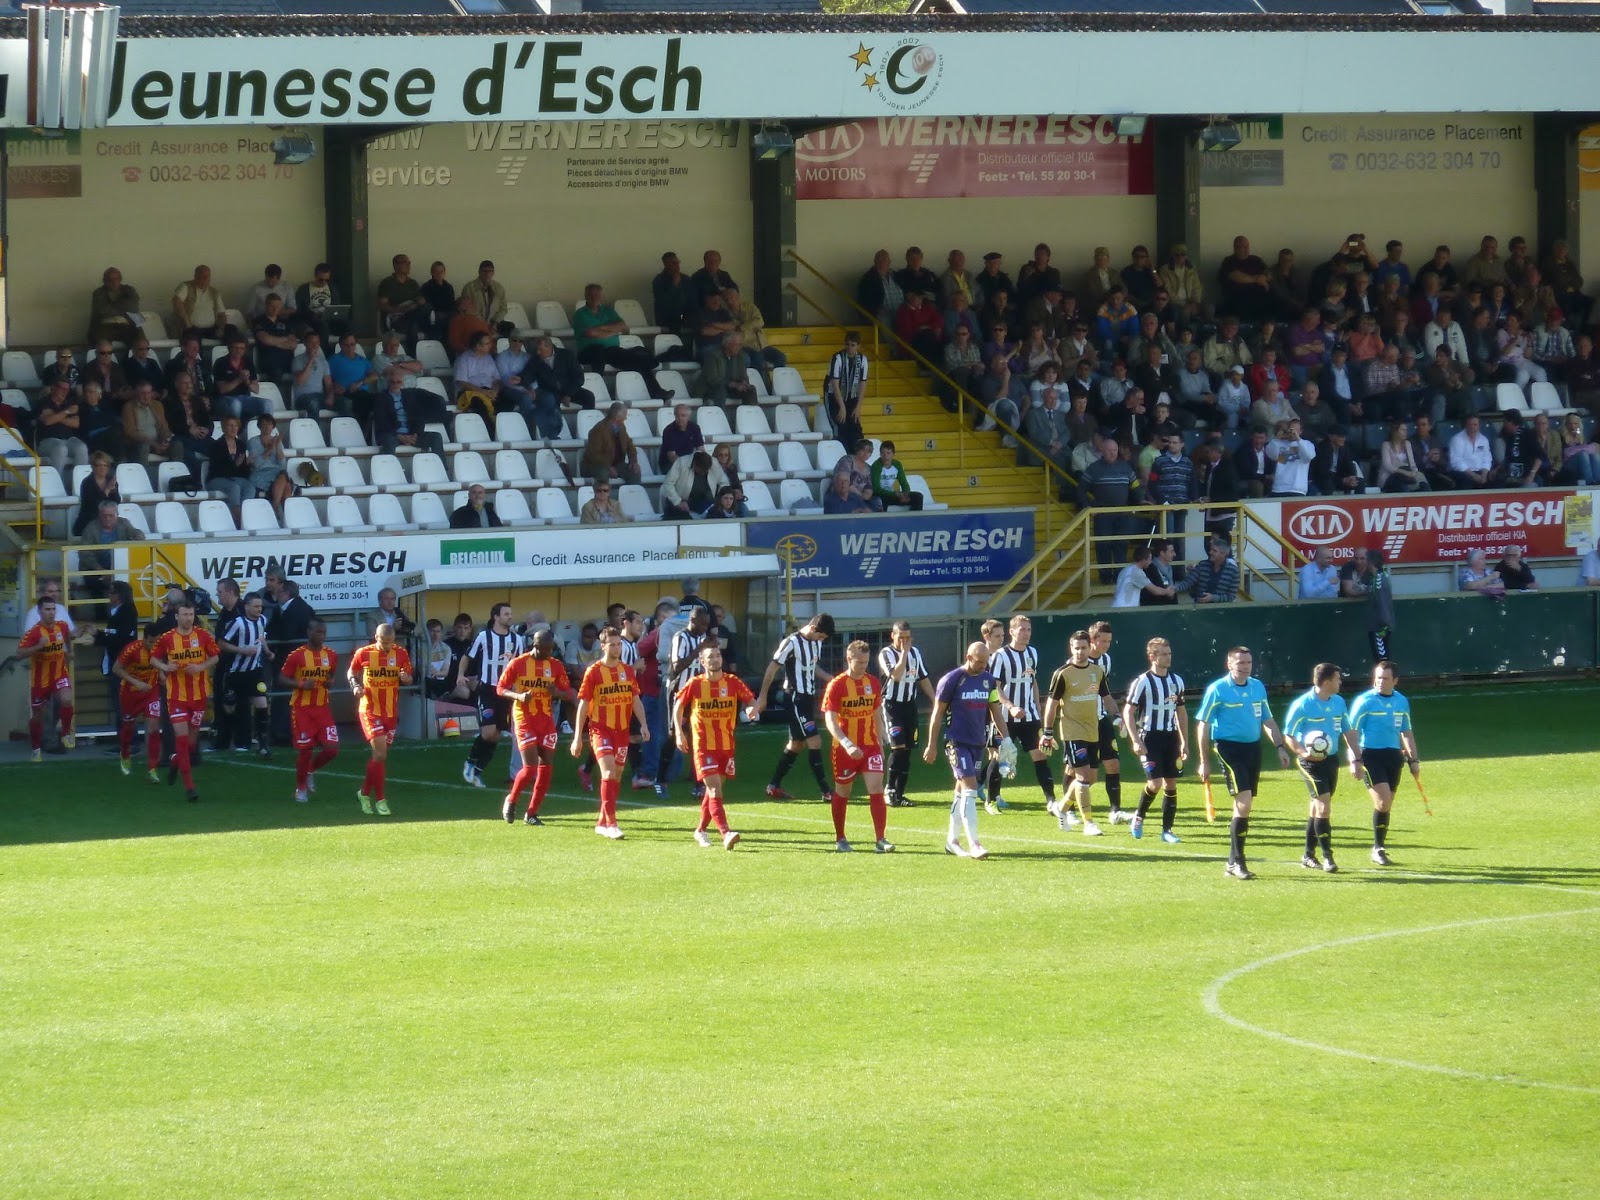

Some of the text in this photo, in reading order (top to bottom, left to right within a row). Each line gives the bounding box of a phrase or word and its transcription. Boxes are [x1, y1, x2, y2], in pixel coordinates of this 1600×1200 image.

[897, 38, 920, 46] 2007
[107, 37, 703, 120] Jeunesse d'Esch
[908, 81, 939, 110] JEUNESSE
[367, 119, 740, 151] MW WERNER ESCH
[878, 116, 1038, 147] WERNER
[1302, 124, 1522, 143] Credit Assurance Placement
[96, 141, 142, 156] Credit
[150, 140, 228, 155] Assurance
[567, 158, 606, 166] Partenaire
[607, 157, 617, 165] de
[618, 157, 646, 165] Service
[978, 152, 1095, 165] Distributeur officiel KIA
[1202, 152, 1272, 169] INANCES
[1355, 151, 1501, 171] 0032-632 304 70
[150, 164, 294, 182] 0032-632 304 70
[634, 168, 667, 177] d'origine
[669, 167, 689, 175] BMW
[805, 167, 866, 181] MOTORS
[978, 170, 1096, 182] Foetz Tel. 55 20 30-1
[567, 179, 670, 188] Accessoires d'origine BMW
[1300, 514, 1344, 536] KIA
[1362, 503, 1485, 533] WERNER
[1487, 500, 1564, 528] ESCH
[840, 527, 1023, 556] WERNER ESCH
[1438, 530, 1527, 543] Distributeur officiel KIA
[1438, 548, 1461, 557] Foetz
[1485, 546, 1496, 555] 55
[201, 550, 408, 580] WERNER ESCH
[531, 554, 567, 566] Credit
[574, 551, 636, 565] Assurance
[944, 556, 964, 564] officiel
[965, 555, 989, 563] SUBARU
[909, 565, 990, 576] Foetz Tel. 55 20 30-1
[322, 580, 347, 589] officiel
[350, 580, 368, 588] OPEL
[309, 593, 325, 601] Tel.
[339, 592, 350, 600] 20
[351, 591, 369, 599] 30-1
[600, 682, 632, 695] LAVAZZA
[698, 699, 733, 710] LAVAZZA
[960, 757, 967, 770] 1
